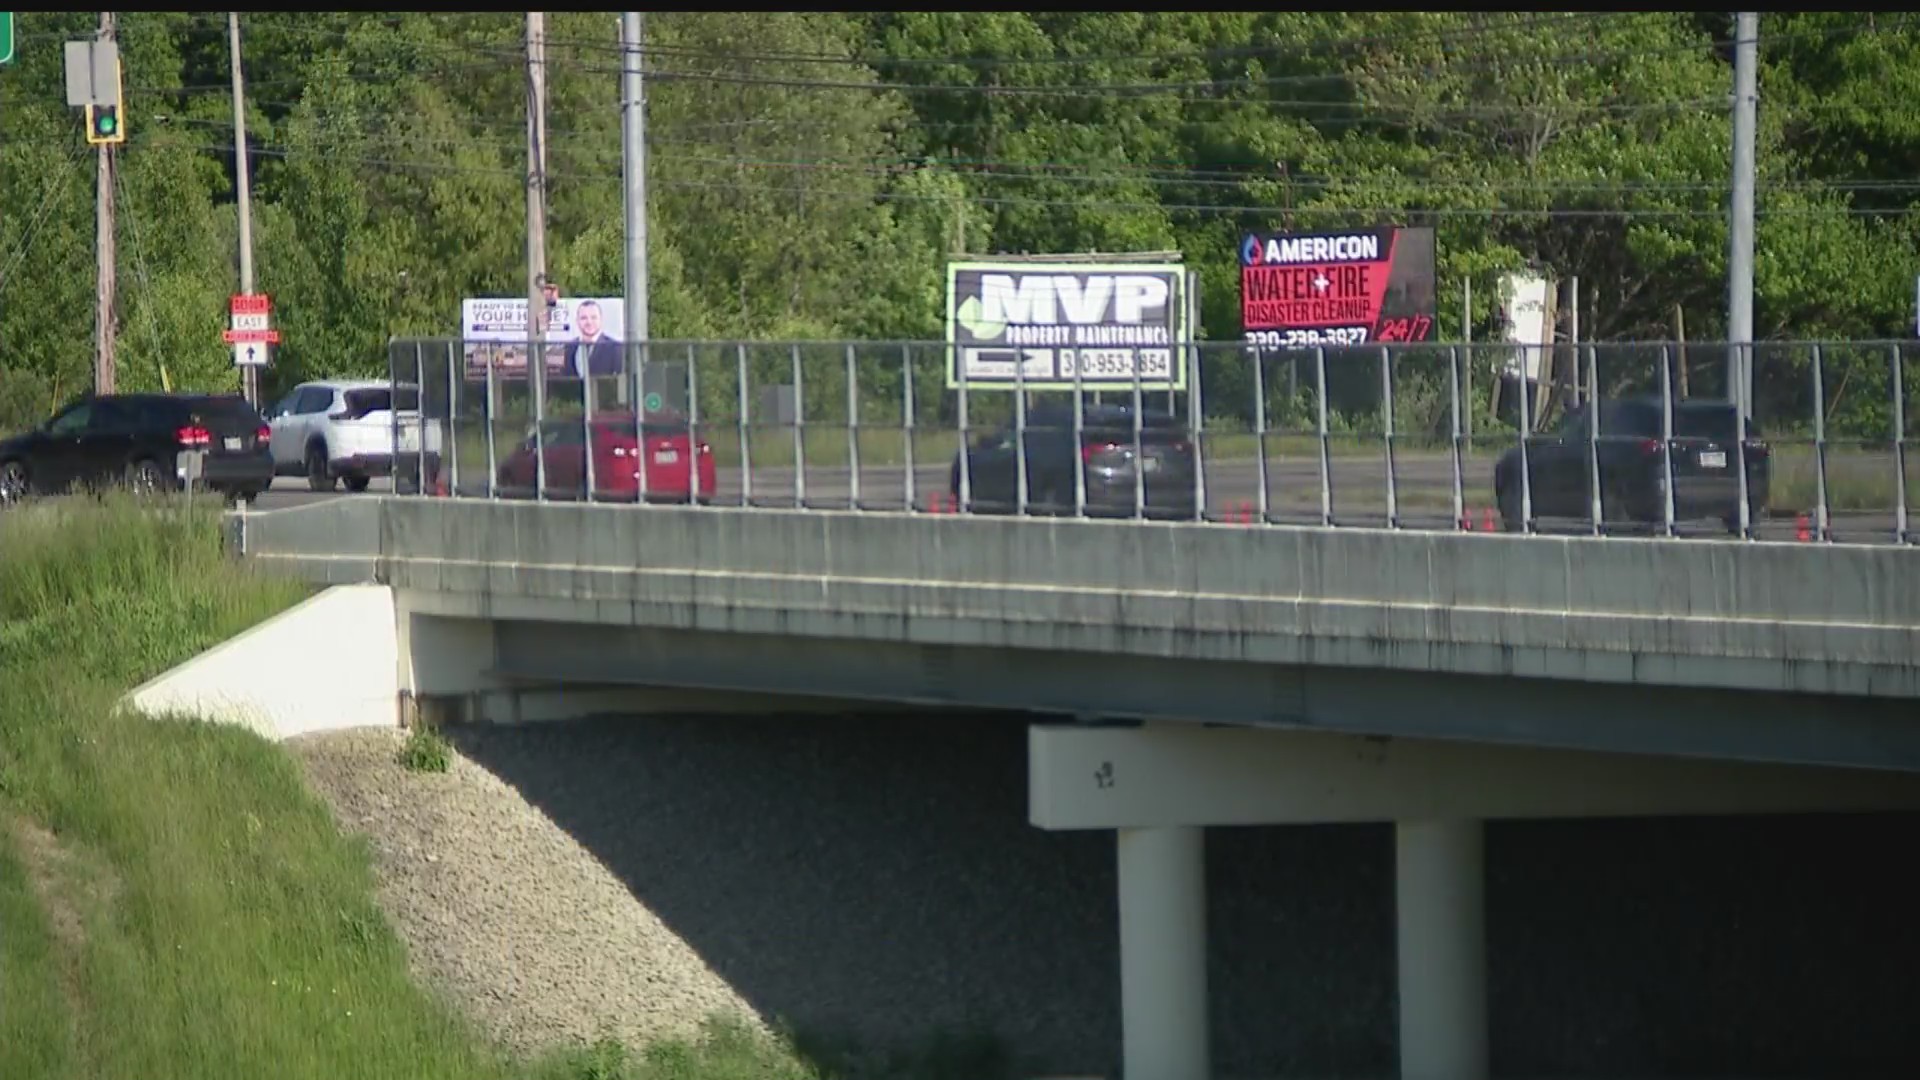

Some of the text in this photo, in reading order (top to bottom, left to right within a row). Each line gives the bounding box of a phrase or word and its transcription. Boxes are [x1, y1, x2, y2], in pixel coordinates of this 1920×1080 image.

[1265, 235, 1378, 262] AMERICON
[1247, 265, 1370, 302] WATER FIRE
[981, 274, 1169, 324] MVP
[237, 316, 261, 327] EAST
[473, 311, 512, 321] YOUR
[1247, 300, 1371, 324] DISASTER CLEANUP
[1006, 326, 1169, 345] PROPERTY MAINTENANCE
[1378, 312, 1431, 344] 24/7
